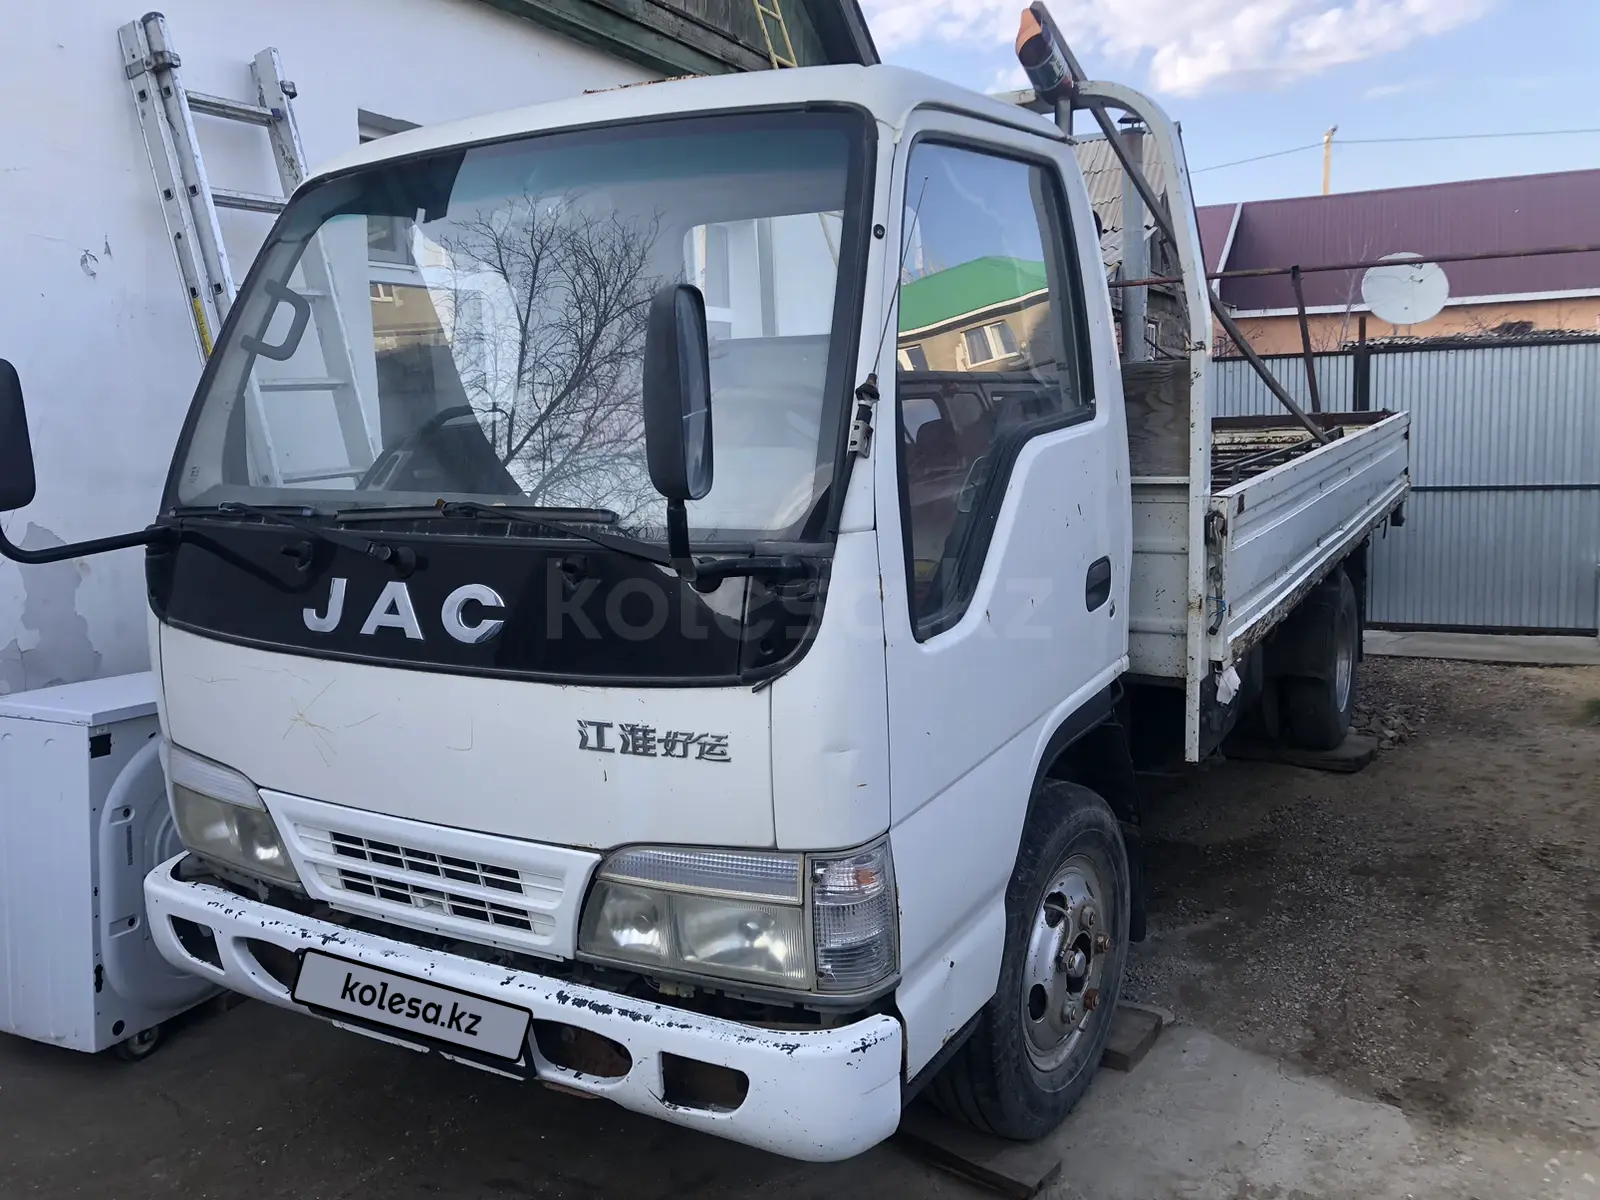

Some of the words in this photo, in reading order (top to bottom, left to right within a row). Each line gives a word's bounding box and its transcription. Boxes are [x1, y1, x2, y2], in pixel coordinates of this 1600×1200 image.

[302, 577, 506, 644] JAC
[576, 718, 732, 763] 江淮好运
